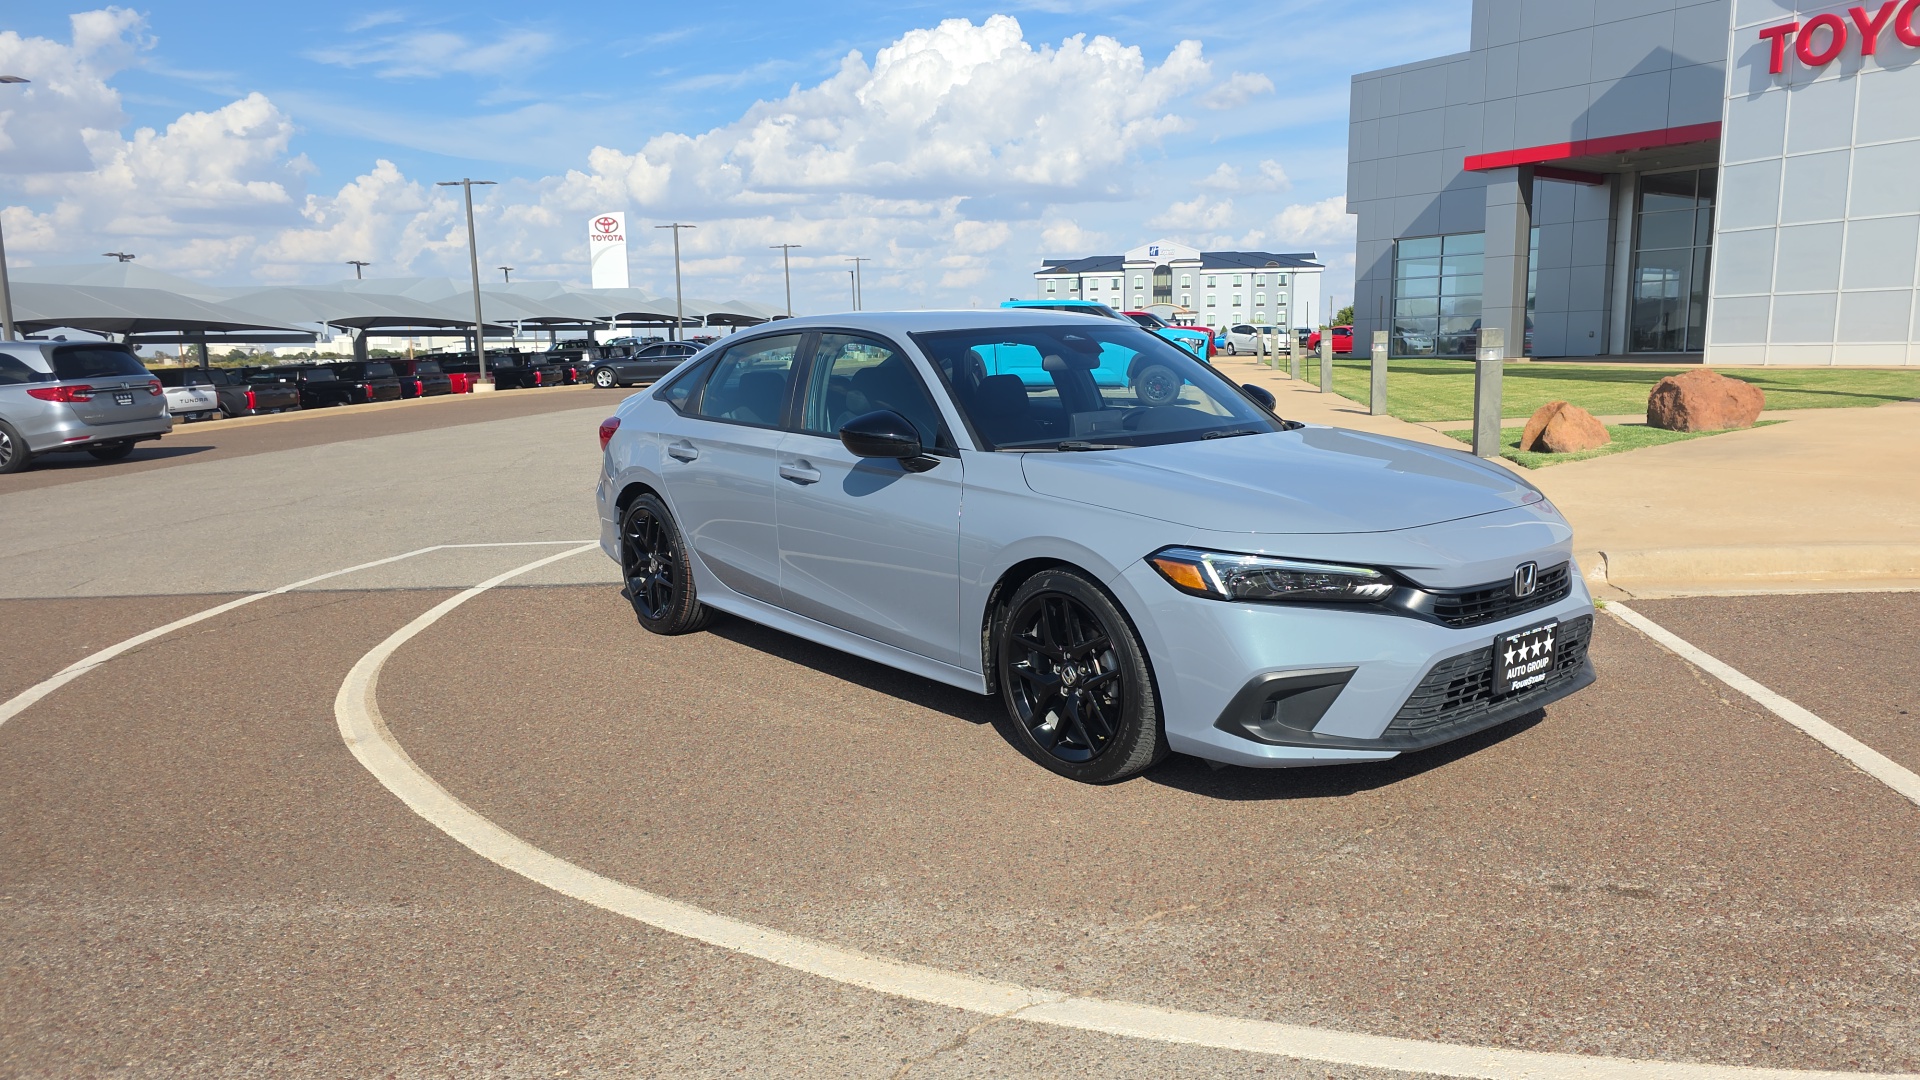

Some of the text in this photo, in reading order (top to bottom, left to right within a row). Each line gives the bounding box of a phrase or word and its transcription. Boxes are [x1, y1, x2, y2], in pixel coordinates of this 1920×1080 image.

[591, 234, 624, 242] TOYOTA
[1506, 656, 1550, 680] AUTO GROUP
